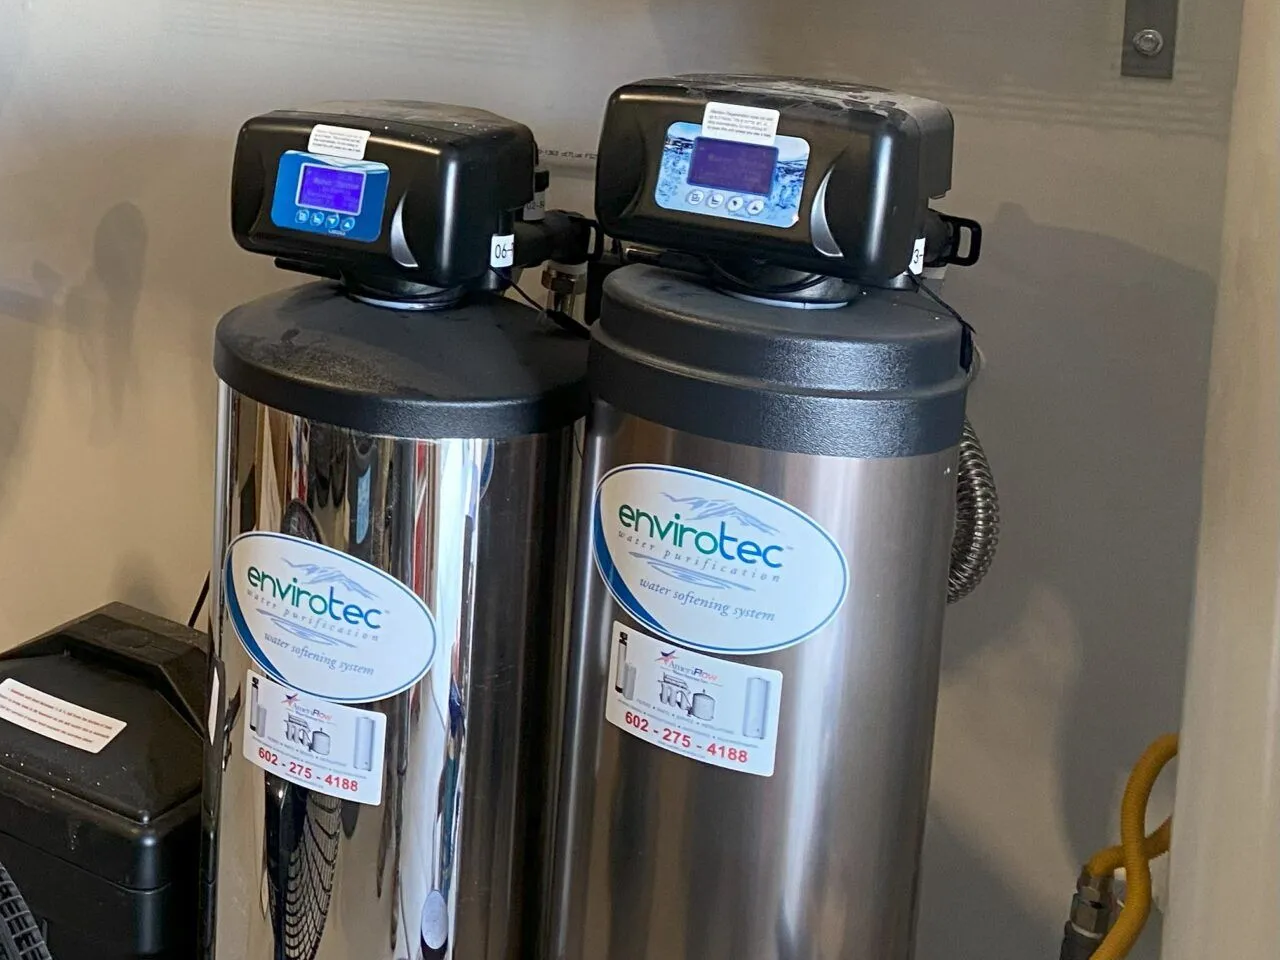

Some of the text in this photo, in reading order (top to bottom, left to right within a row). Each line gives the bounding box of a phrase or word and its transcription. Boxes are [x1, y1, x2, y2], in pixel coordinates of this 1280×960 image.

[618, 504, 784, 568] envirotec
[618, 530, 780, 583] water purification
[247, 566, 383, 630] envirotec
[247, 589, 380, 642] water purification
[639, 578, 775, 622] water softening system
[264, 632, 374, 676] water softening system
[625, 711, 649, 732] 602
[662, 728, 691, 748] 275
[707, 743, 748, 763] 4188
[258, 747, 278, 766] 602
[289, 762, 312, 779] 275
[324, 774, 358, 792] 4188
